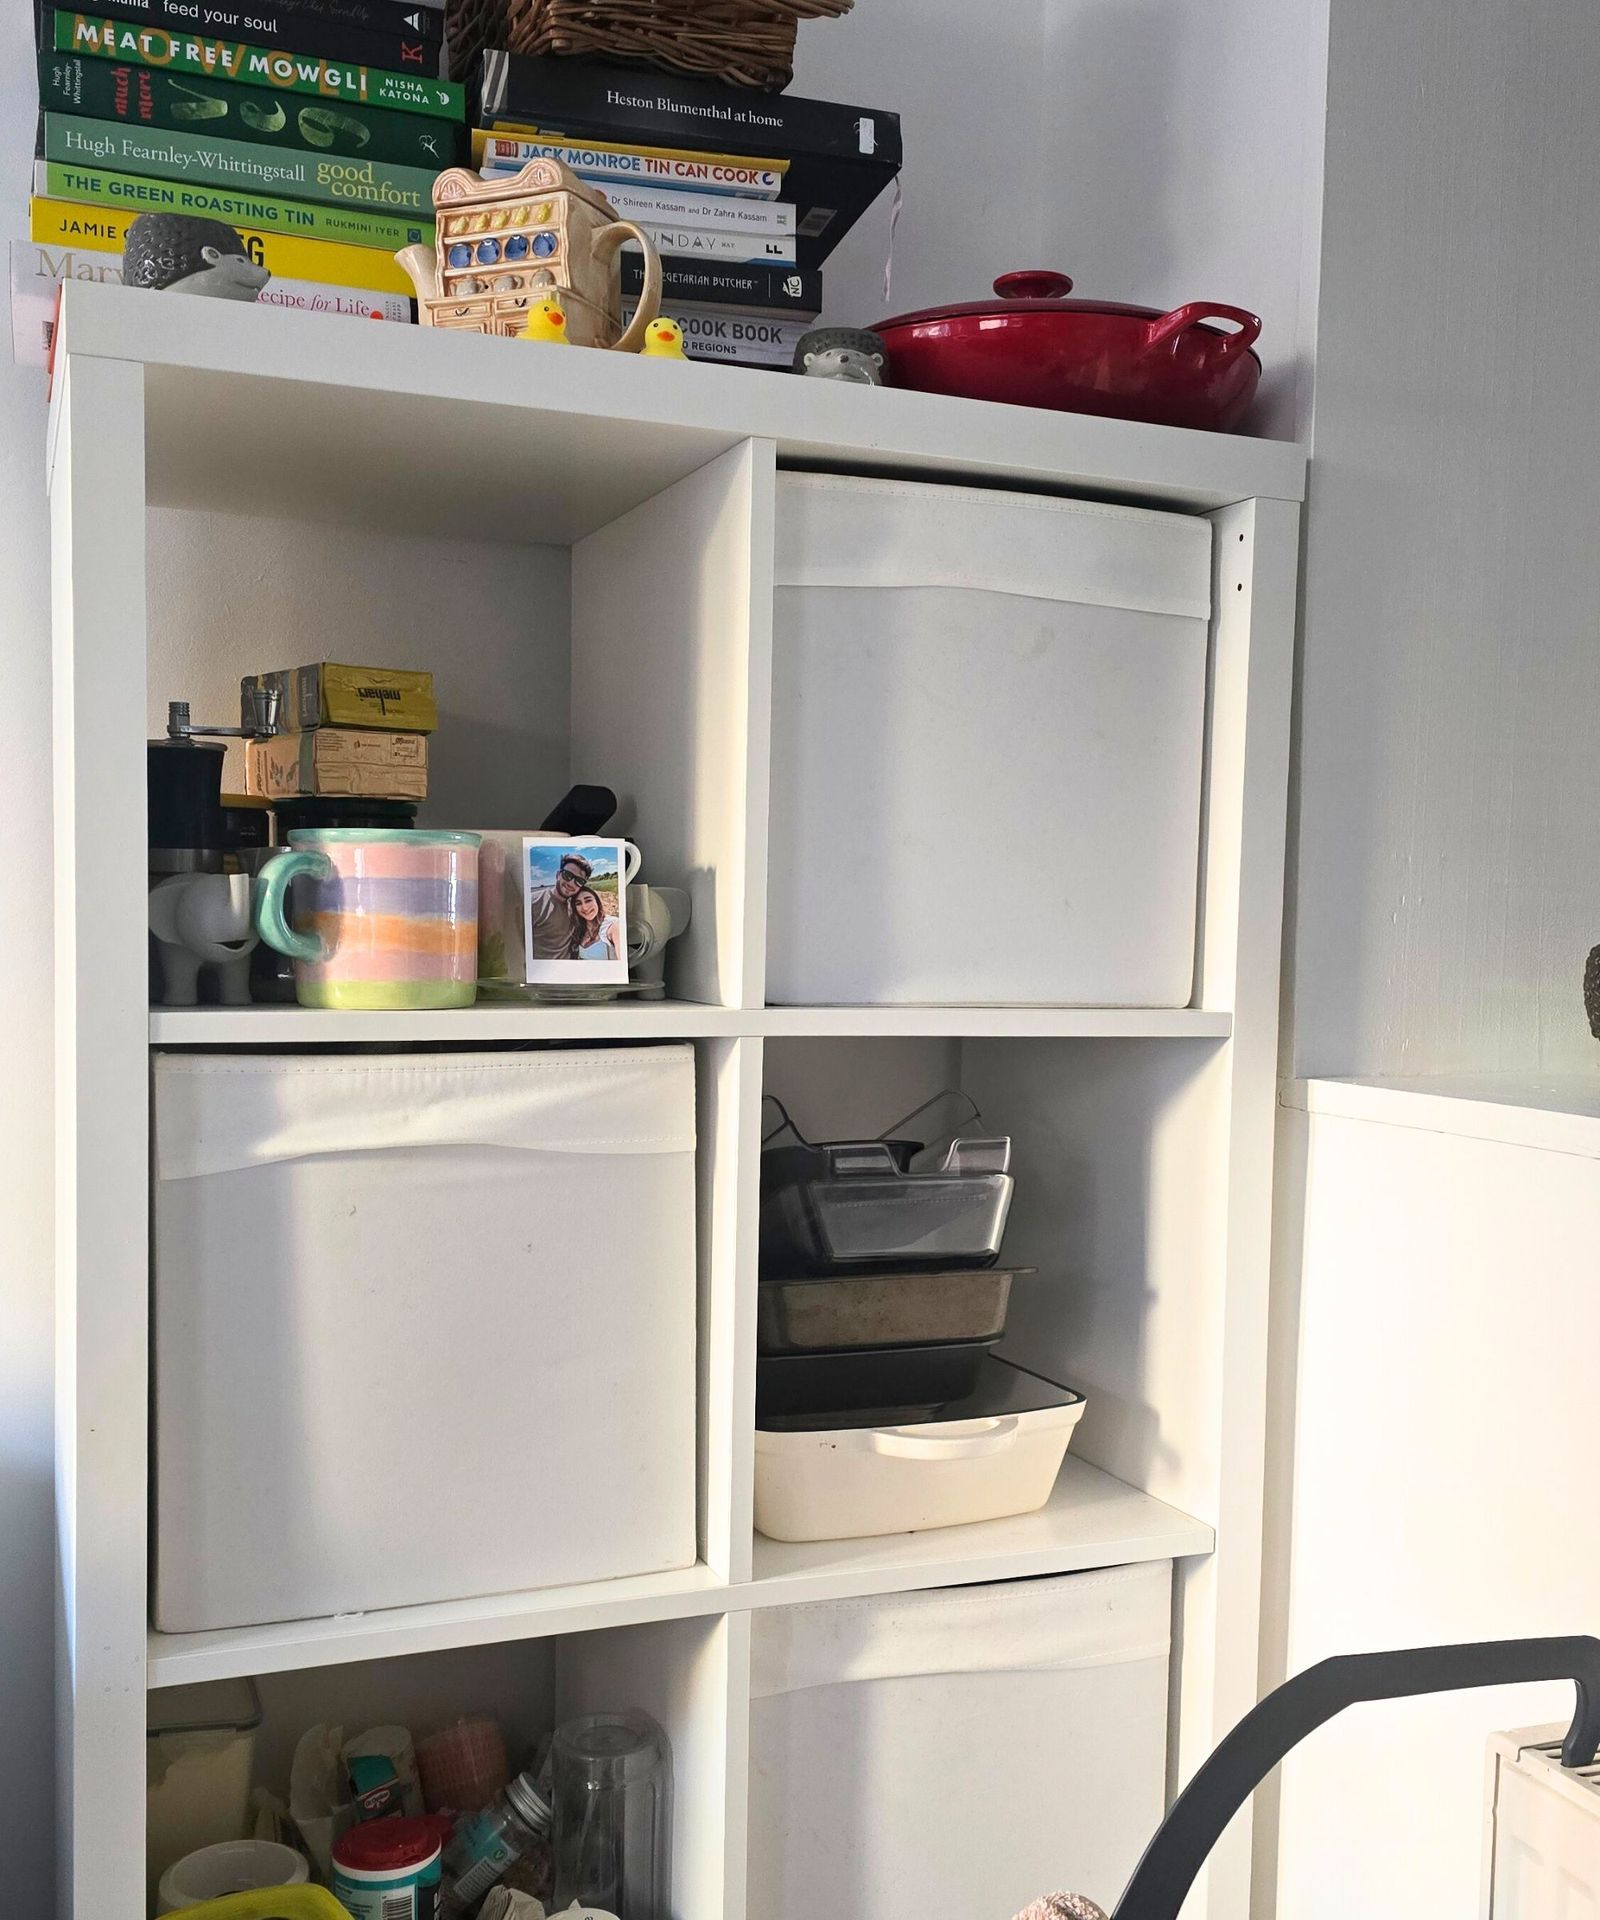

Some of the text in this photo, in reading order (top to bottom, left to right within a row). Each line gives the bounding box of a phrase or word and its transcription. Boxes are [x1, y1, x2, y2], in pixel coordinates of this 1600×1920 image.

[163, 0, 199, 18] feed
[203, 9, 239, 25] your
[243, 16, 278, 33] soul
[76, 23, 367, 91] MEAT FREE MOWGLI
[401, 41, 423, 64] K
[53, 66, 63, 87] Hugh
[385, 78, 424, 92] NISHA
[110, 67, 131, 115] much
[379, 88, 430, 105] KATONA
[606, 90, 784, 127] Heston Blumenthal at home
[65, 131, 306, 182] Hugh Fearnley-Whittingstall
[522, 144, 759, 185] JACK MONROE TIN CAN COOK
[316, 161, 374, 185] good
[63, 173, 315, 226] THE GREEN ROASTING TIN
[331, 181, 421, 207] comfort
[611, 195, 621, 205] Dr
[623, 197, 653, 209] Shireen
[655, 201, 686, 213] Kassam
[688, 206, 700, 215] and
[702, 206, 712, 216] Dr
[714, 208, 735, 219] Zahra
[737, 211, 768, 223] Kassam
[59, 219, 117, 239] JAMIE
[325, 218, 400, 237] RUKMINI IYER
[765, 244, 783, 255] LL
[257, 289, 306, 308] ecipe
[310, 294, 332, 311] for
[335, 297, 371, 317] Life
[677, 317, 783, 345] COOK BOOK
[691, 342, 738, 355] REGIONS
